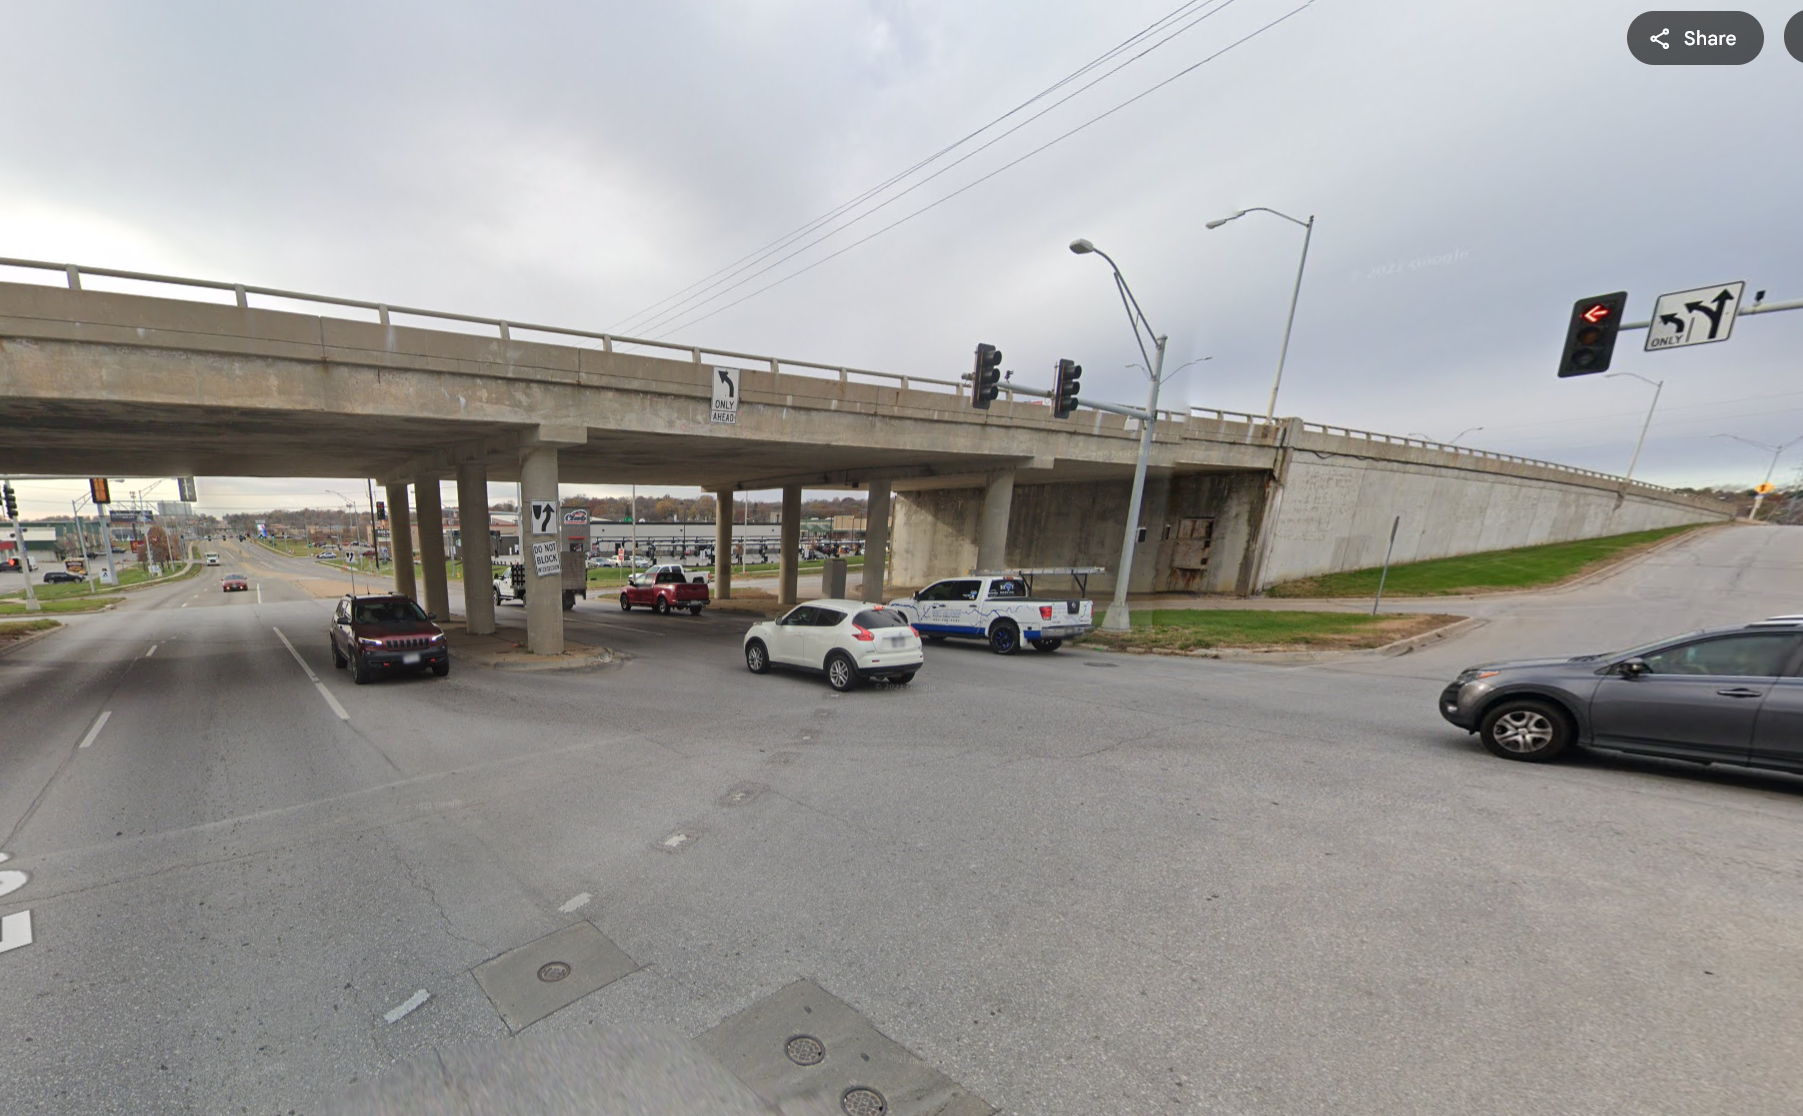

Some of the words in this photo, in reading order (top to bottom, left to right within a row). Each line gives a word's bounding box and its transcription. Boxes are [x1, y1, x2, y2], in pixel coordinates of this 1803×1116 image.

[1650, 334, 1684, 348] ONLY
[715, 399, 734, 409] ONLY
[713, 412, 734, 422] AHEAD
[533, 545, 543, 554] DO
[544, 543, 556, 552] NOT
[536, 554, 558, 565] BLOCK
[858, 1097, 869, 1112] GAS
